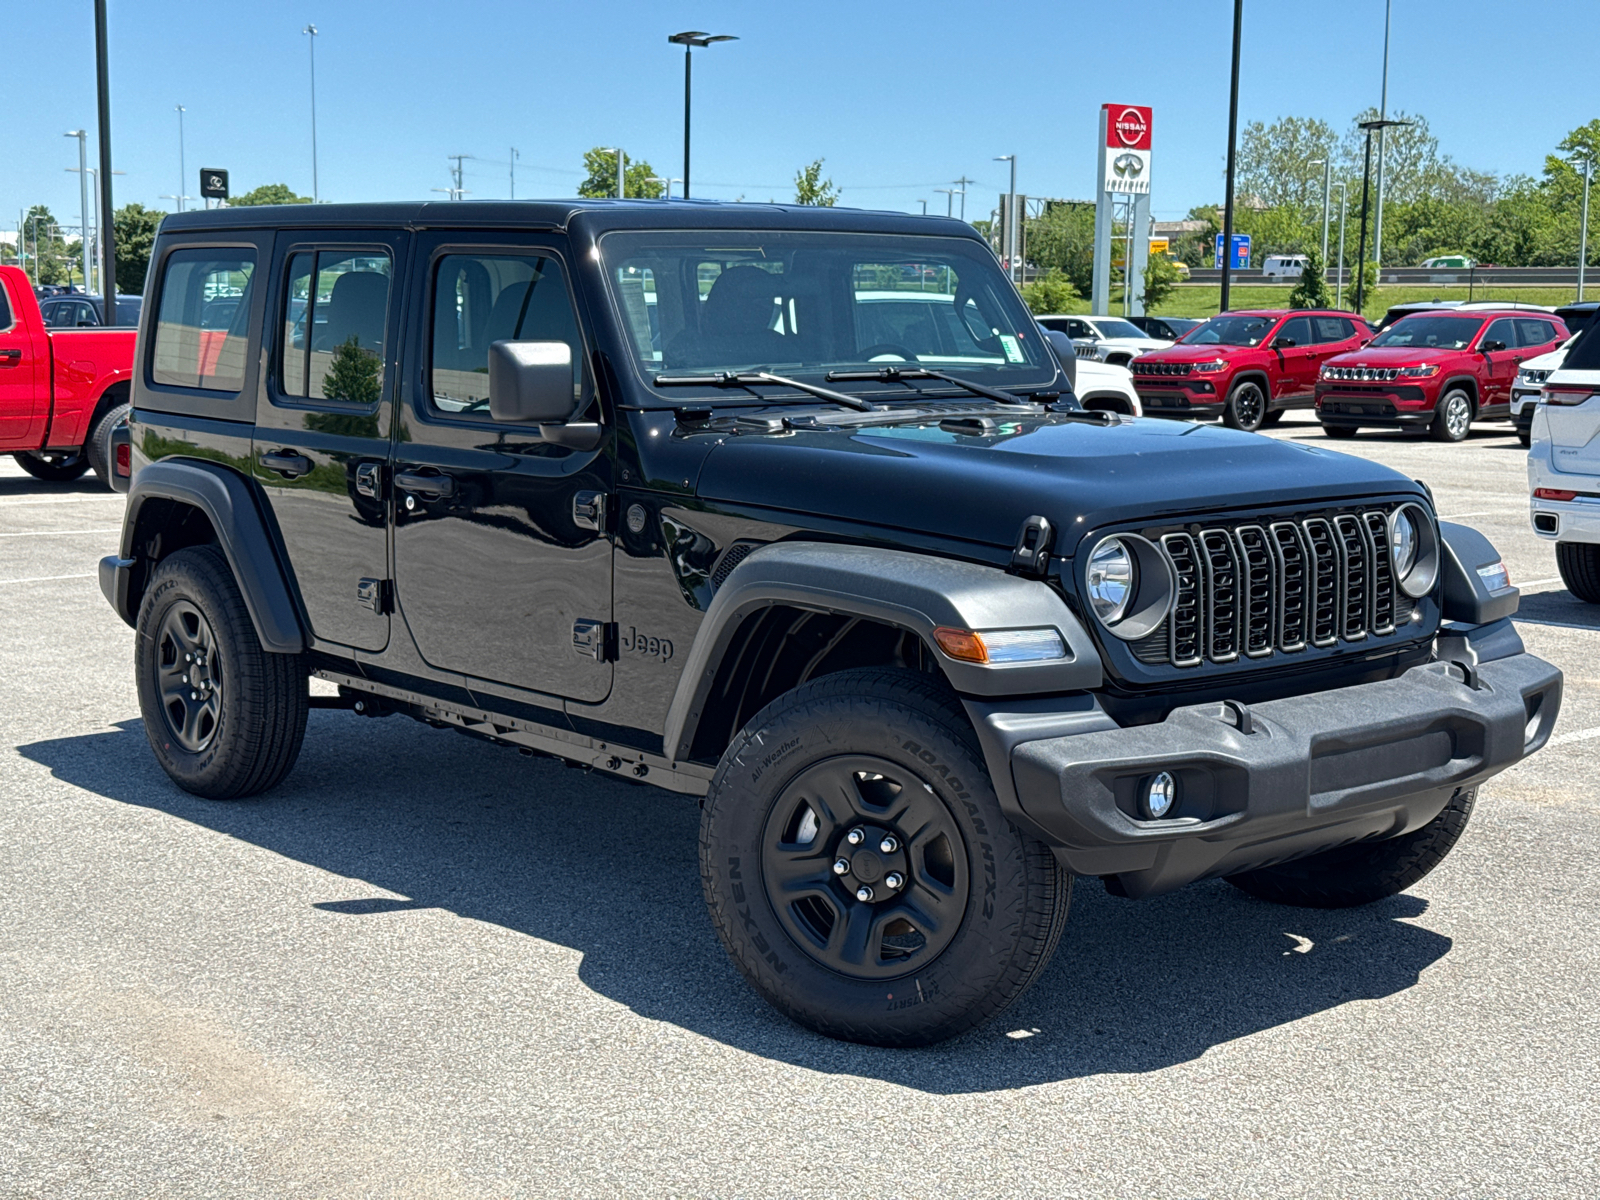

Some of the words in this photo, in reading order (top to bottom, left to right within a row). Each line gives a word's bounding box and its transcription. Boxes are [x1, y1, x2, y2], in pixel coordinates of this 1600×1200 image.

[1115, 121, 1147, 132] NISSAN
[621, 626, 674, 663] Jeep
[751, 737, 800, 783] All-Weather
[902, 740, 988, 836] ROADIAN
[980, 841, 997, 920] HTX2
[728, 857, 788, 974] NEXEN
[886, 988, 940, 1012] 24575R17
